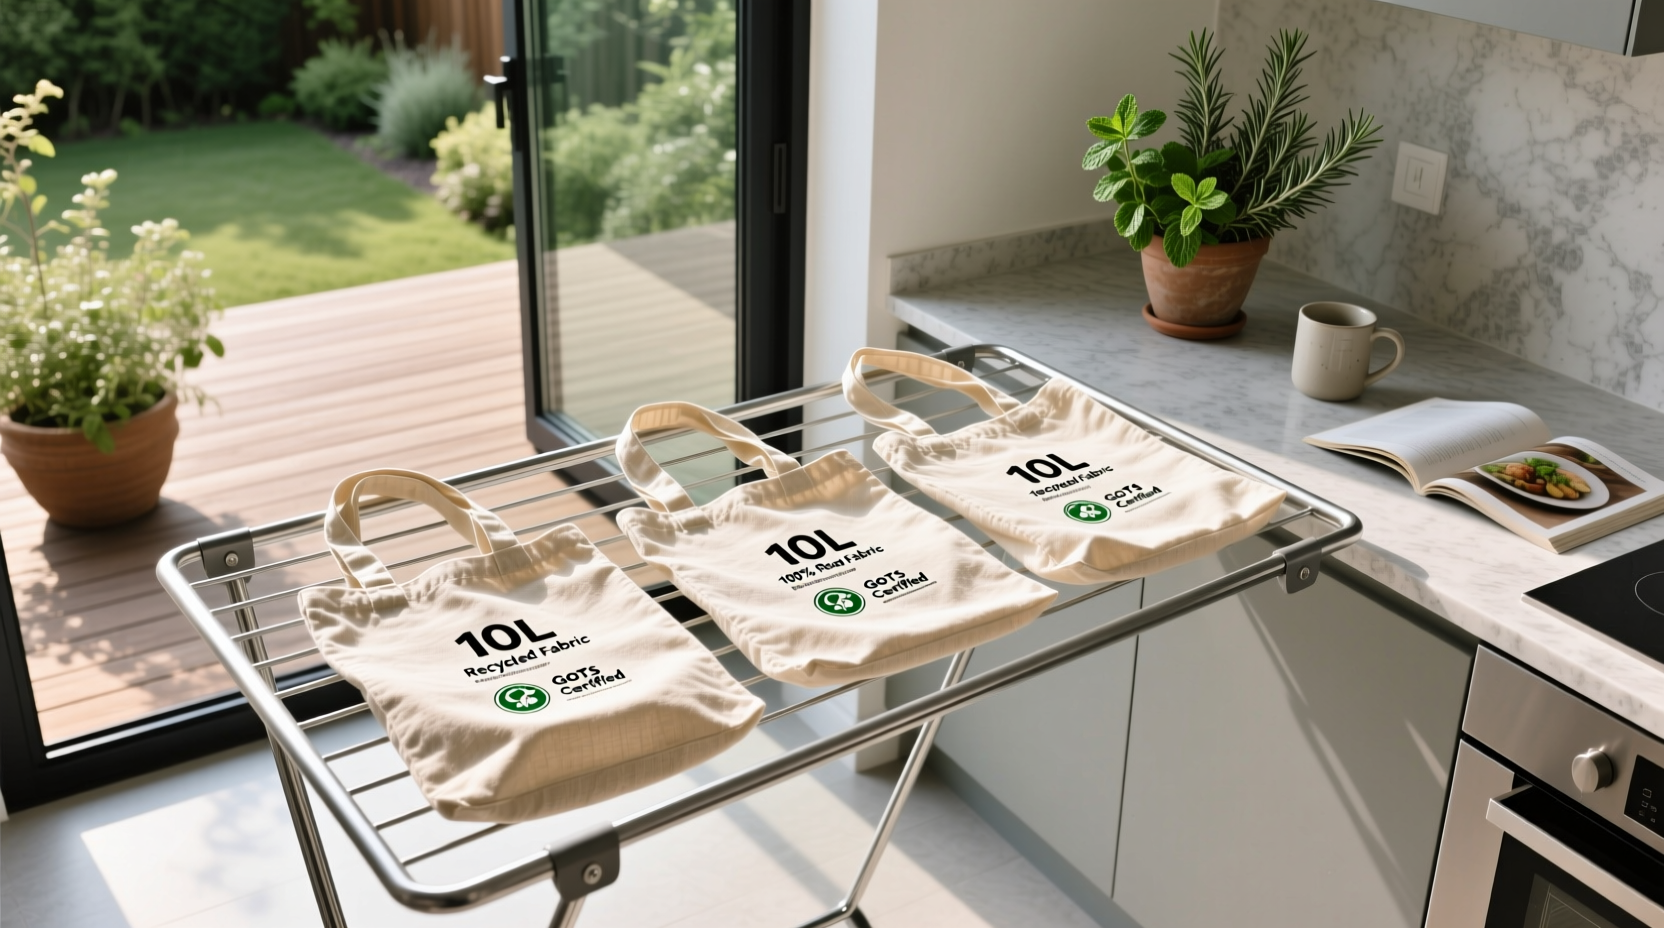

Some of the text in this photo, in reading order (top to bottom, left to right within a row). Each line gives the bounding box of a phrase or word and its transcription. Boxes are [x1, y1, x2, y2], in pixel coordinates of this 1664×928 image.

[1006, 453, 1091, 484] 10L
[764, 529, 858, 566] 10L
[863, 570, 906, 589] GOTS
[454, 618, 558, 658] 10L
[463, 649, 538, 678] Recycled
[538, 636, 591, 657] Fabric
[551, 665, 601, 686] GOTS
